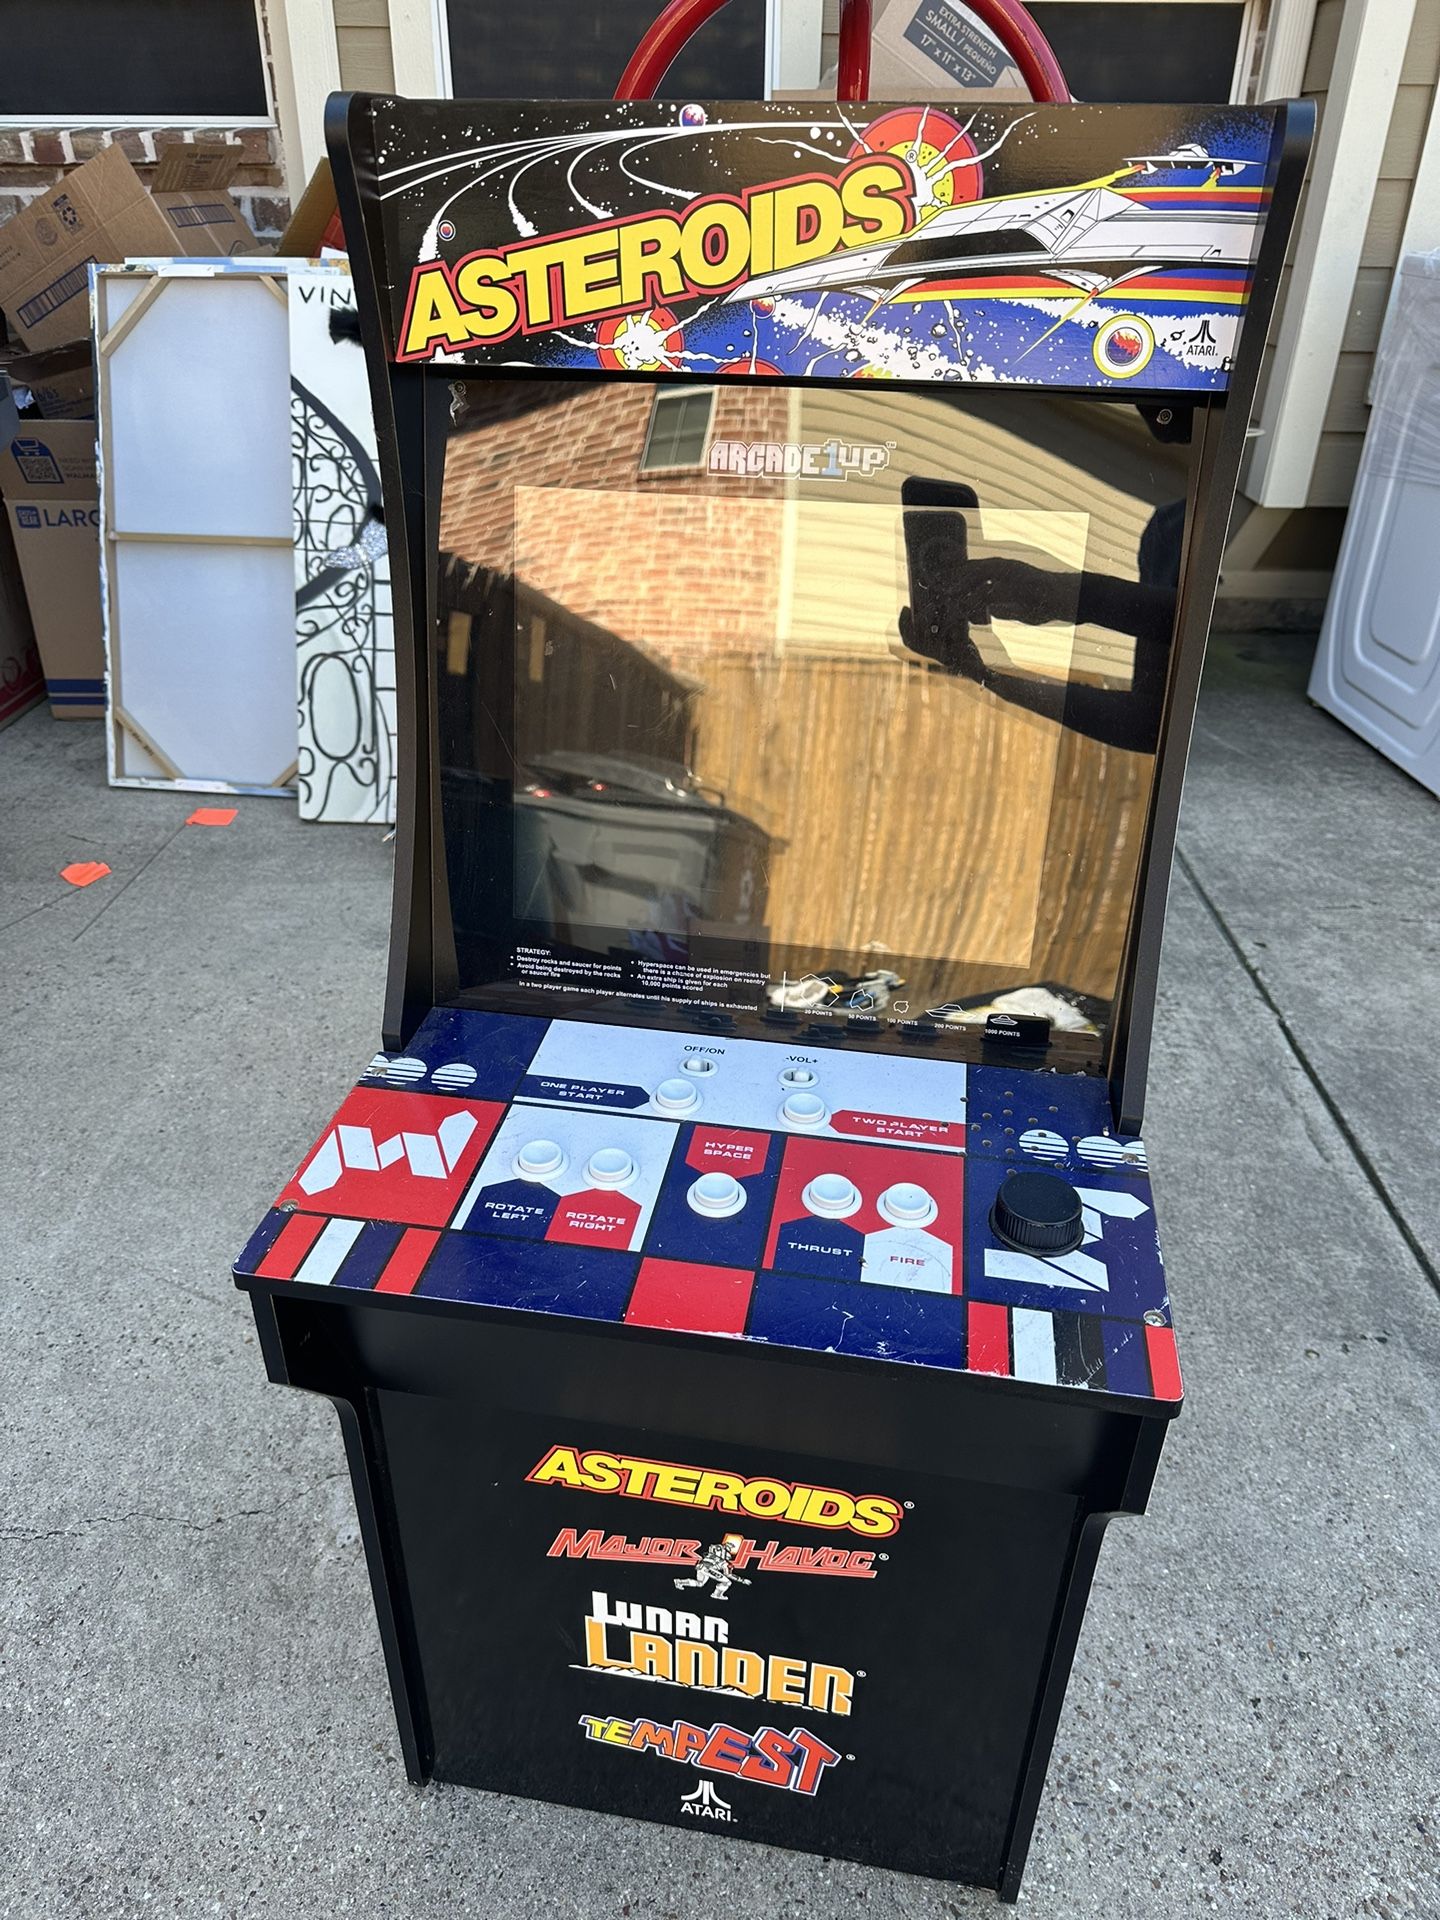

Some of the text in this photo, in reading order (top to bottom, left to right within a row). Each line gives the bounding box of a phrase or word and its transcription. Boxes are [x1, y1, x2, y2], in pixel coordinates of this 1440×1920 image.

[939, 6, 998, 58] EXTRA STRENGTH
[925, 10, 957, 42] SMALL
[962, 44, 997, 75] PEQUEÑO
[920, 34, 936, 47] 17"
[942, 51, 956, 65] 11"
[961, 69, 977, 82] 13"
[397, 154, 917, 362] ASTEROIDS
[298, 286, 351, 306] VIN
[1186, 345, 1216, 356] ATARI
[516, 947, 552, 956] STRATEGY:
[516, 955, 540, 964] Destroy
[602, 964, 622, 972] points
[516, 962, 534, 970] Avoid
[536, 964, 552, 972] being
[554, 966, 584, 975] destroyed
[638, 960, 674, 970] Hyperspace
[696, 966, 712, 974] used
[720, 969, 759, 979] emergencies
[664, 976, 676, 984] ship
[685, 978, 702, 986] given
[672, 970, 694, 978] chance
[702, 974, 732, 982] explosion
[743, 978, 766, 986] reentry
[642, 980, 704, 992] 10,000 points scored
[596, 988, 614, 997] player
[616, 991, 645, 1000] alternates
[672, 997, 692, 1006] supply
[701, 1000, 718, 1008] ships
[726, 1003, 758, 1011] exhausted
[856, 1014, 876, 1022] POINTS
[897, 1018, 918, 1026] POINTS
[684, 1045, 726, 1055] OFF/ON
[540, 1081, 625, 1096] ONE PLAYER
[558, 1090, 604, 1100] START
[852, 1116, 949, 1133] TWO PLAYER
[875, 1127, 924, 1138] START
[703, 1149, 752, 1160] SPACE
[704, 1141, 754, 1153] HYPER
[484, 1202, 544, 1215] ROTATE
[492, 1211, 530, 1221] LEFT
[565, 1212, 626, 1225] ROTATE
[569, 1220, 616, 1232] RIGHT
[788, 1242, 853, 1257] THRUST
[890, 1255, 926, 1267] FIRE
[524, 1444, 904, 1538] ASTEROIDS
[546, 1528, 878, 1579] MAJOR HAVOC
[592, 1590, 729, 1643] LUNAR
[584, 1615, 855, 1716] LANDER
[578, 1714, 842, 1796] TEMPEST
[680, 1801, 732, 1822] ATARI
